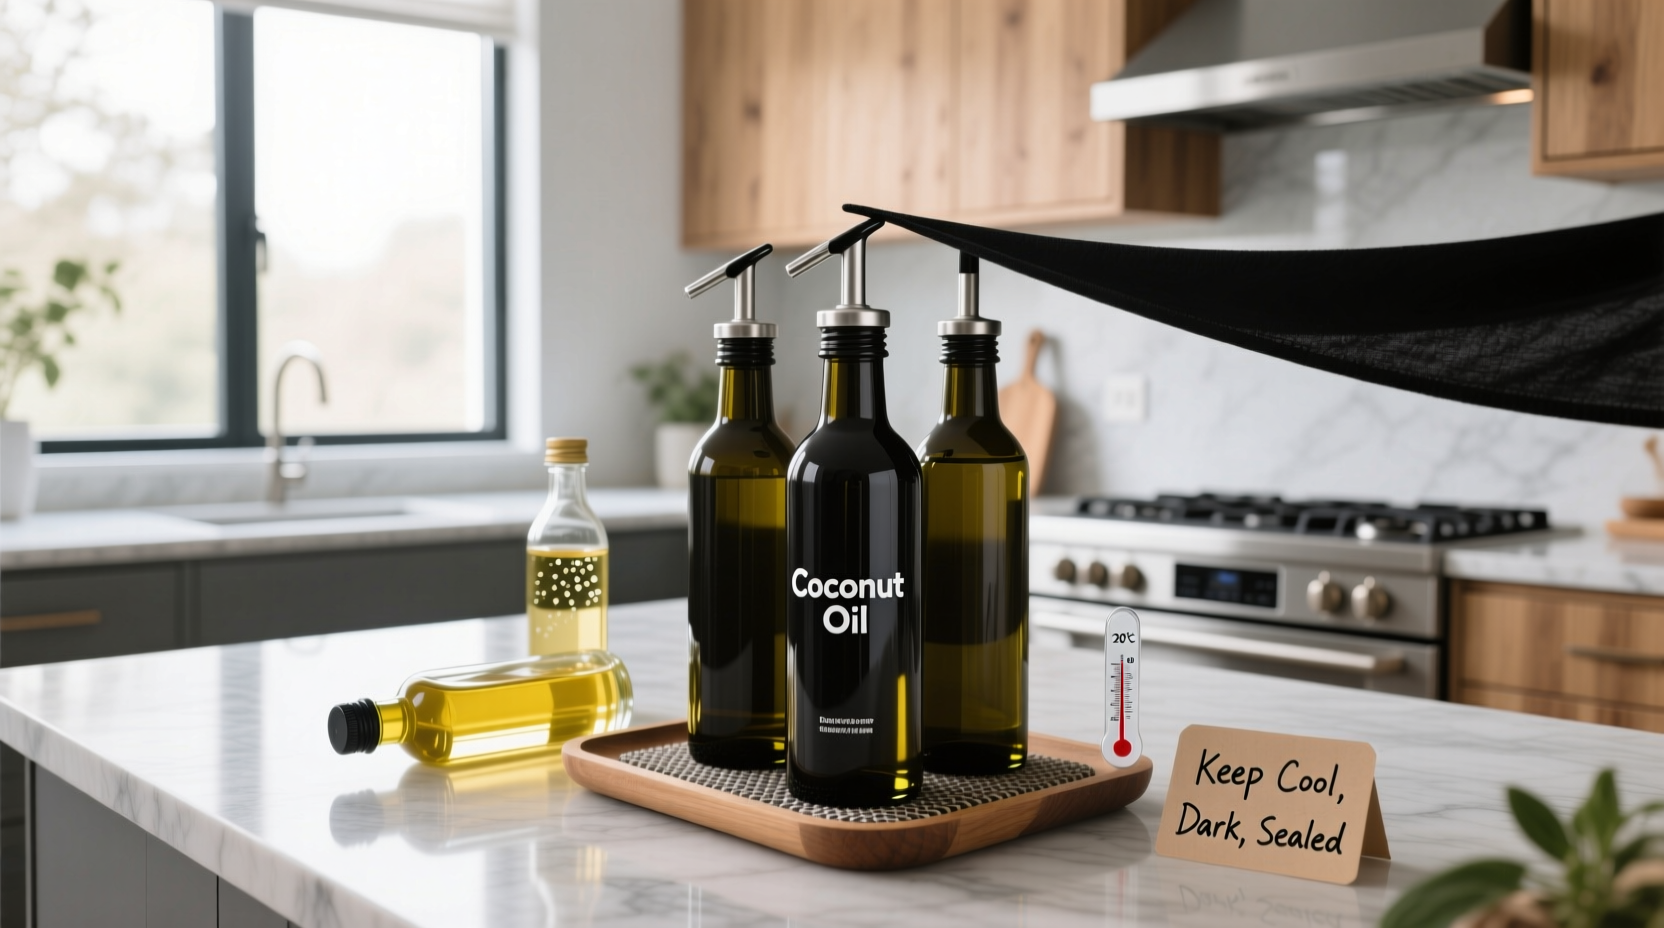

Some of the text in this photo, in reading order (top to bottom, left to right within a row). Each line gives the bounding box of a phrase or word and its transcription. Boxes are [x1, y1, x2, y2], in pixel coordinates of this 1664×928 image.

[792, 568, 904, 599] Coconut
[823, 605, 867, 634] Oil
[1196, 748, 1344, 804] Keep Cool,
[1175, 802, 1346, 855] Dark, Sealed
